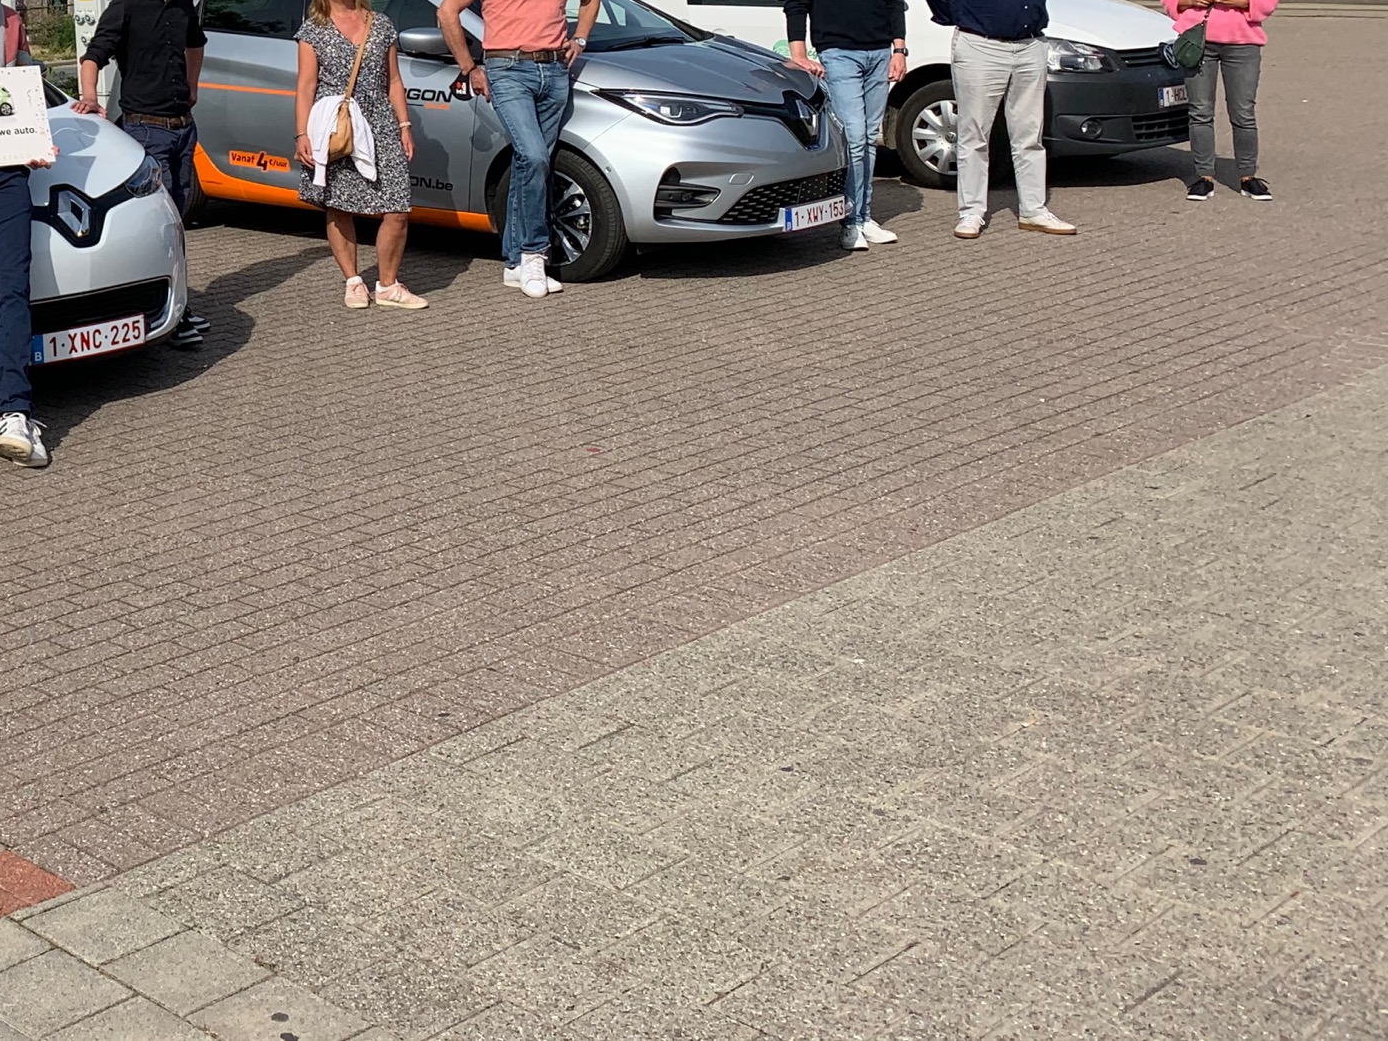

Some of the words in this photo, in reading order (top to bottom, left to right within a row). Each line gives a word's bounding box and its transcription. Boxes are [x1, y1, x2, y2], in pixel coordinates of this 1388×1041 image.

[14, 125, 38, 135] auto.
[231, 152, 255, 164] Vanaf
[256, 152, 268, 171] 4
[34, 351, 42, 362] B
[49, 319, 141, 357] 1-XNC-225
